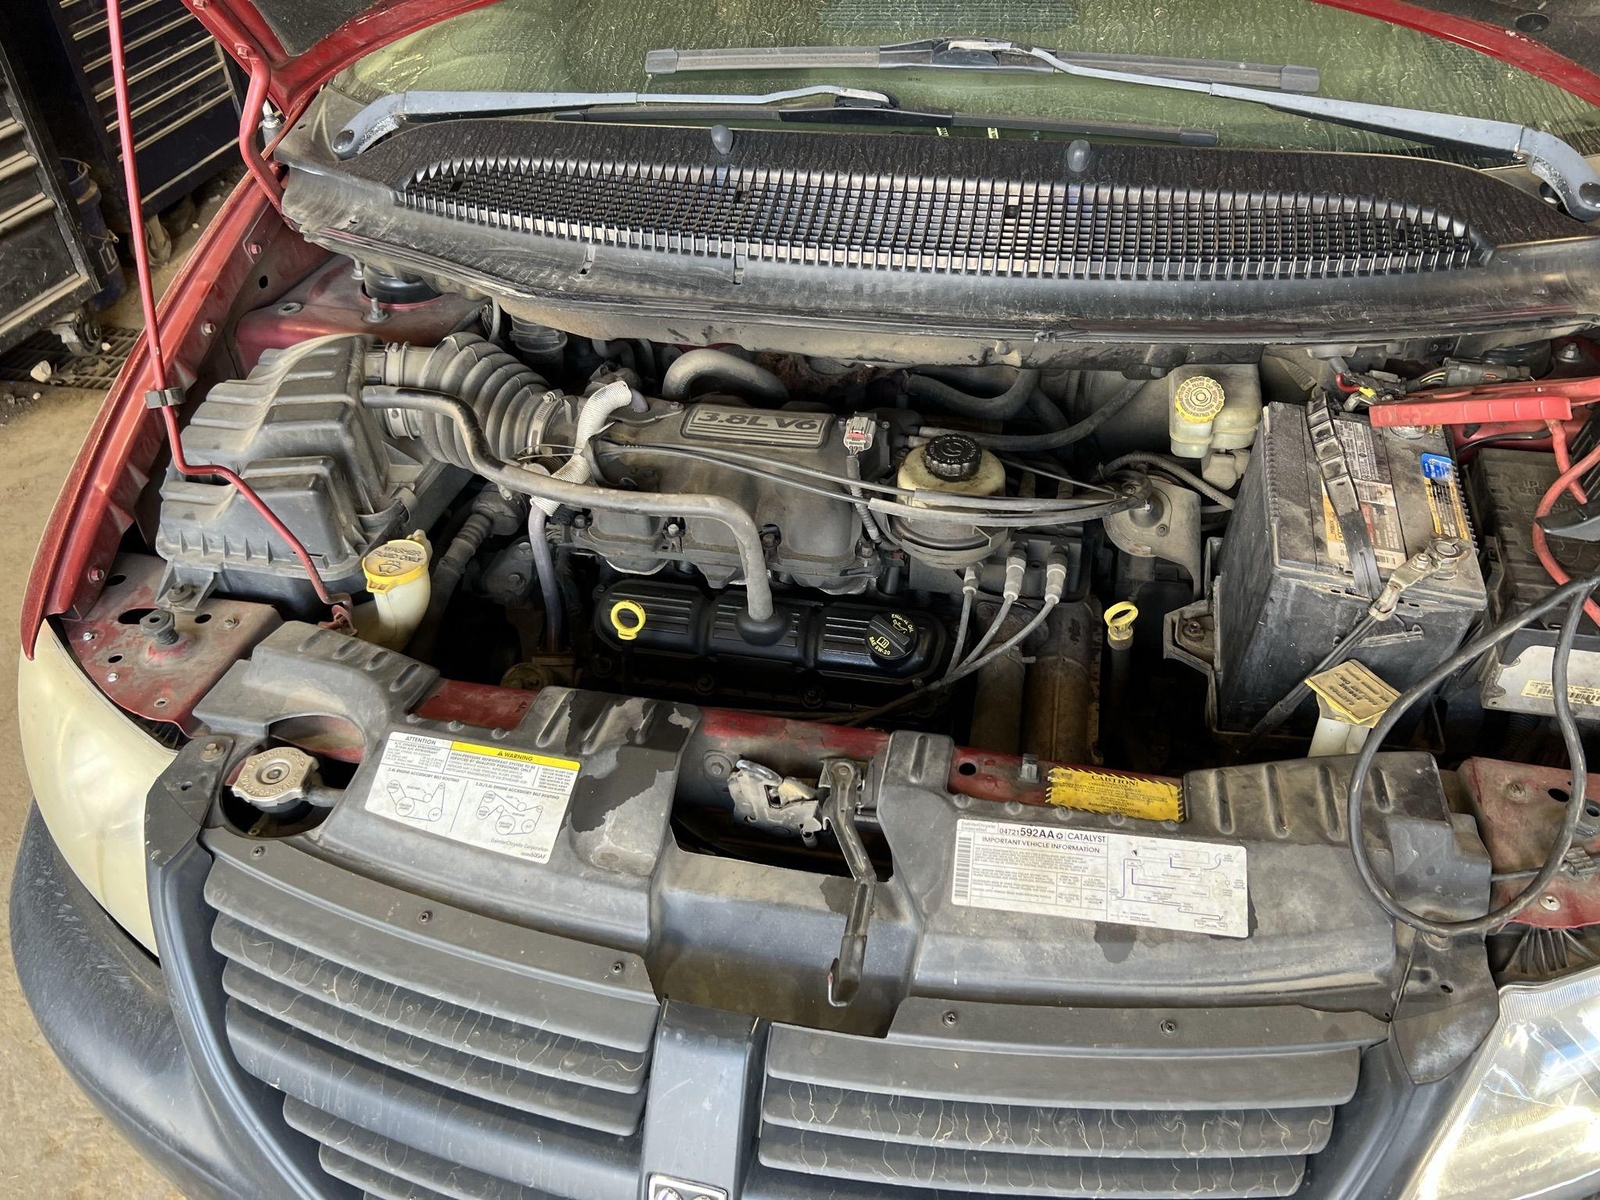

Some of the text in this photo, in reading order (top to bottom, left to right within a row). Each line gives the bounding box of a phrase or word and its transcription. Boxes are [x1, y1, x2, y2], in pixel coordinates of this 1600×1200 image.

[698, 412, 818, 430] 3.8L V6
[875, 645, 891, 656] 5W-20
[1328, 685, 1355, 706] CAUTION
[406, 736, 436, 746] ATTENTION
[504, 752, 532, 761] WARNING
[1068, 833, 1106, 843] CATALYST
[982, 836, 1100, 854] IMPORTANT VEHICLE INFORMATION
